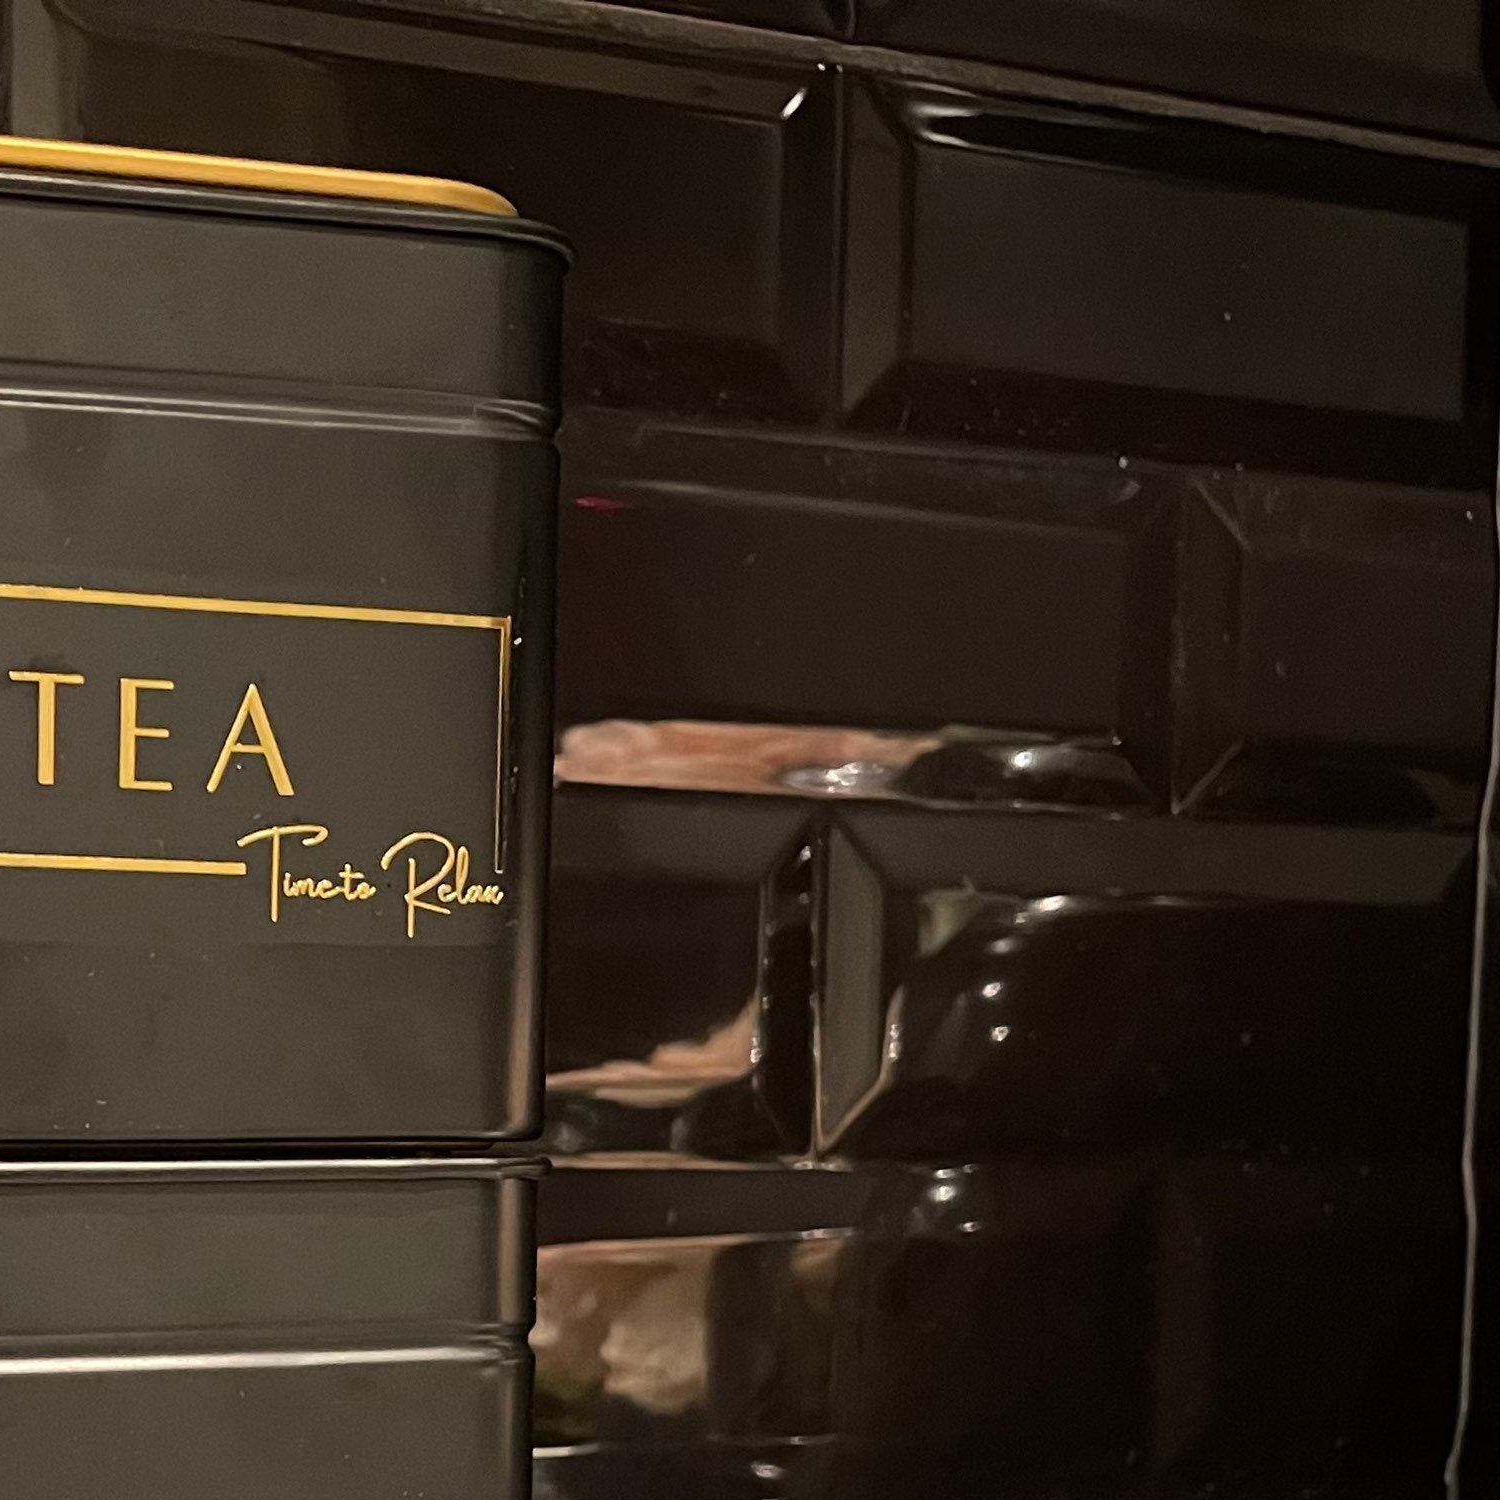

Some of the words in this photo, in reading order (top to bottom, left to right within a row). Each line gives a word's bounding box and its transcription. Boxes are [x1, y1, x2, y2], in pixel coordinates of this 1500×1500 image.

[8, 670, 296, 798] TEA
[236, 824, 336, 923] Time
[380, 831, 504, 938] Relax
